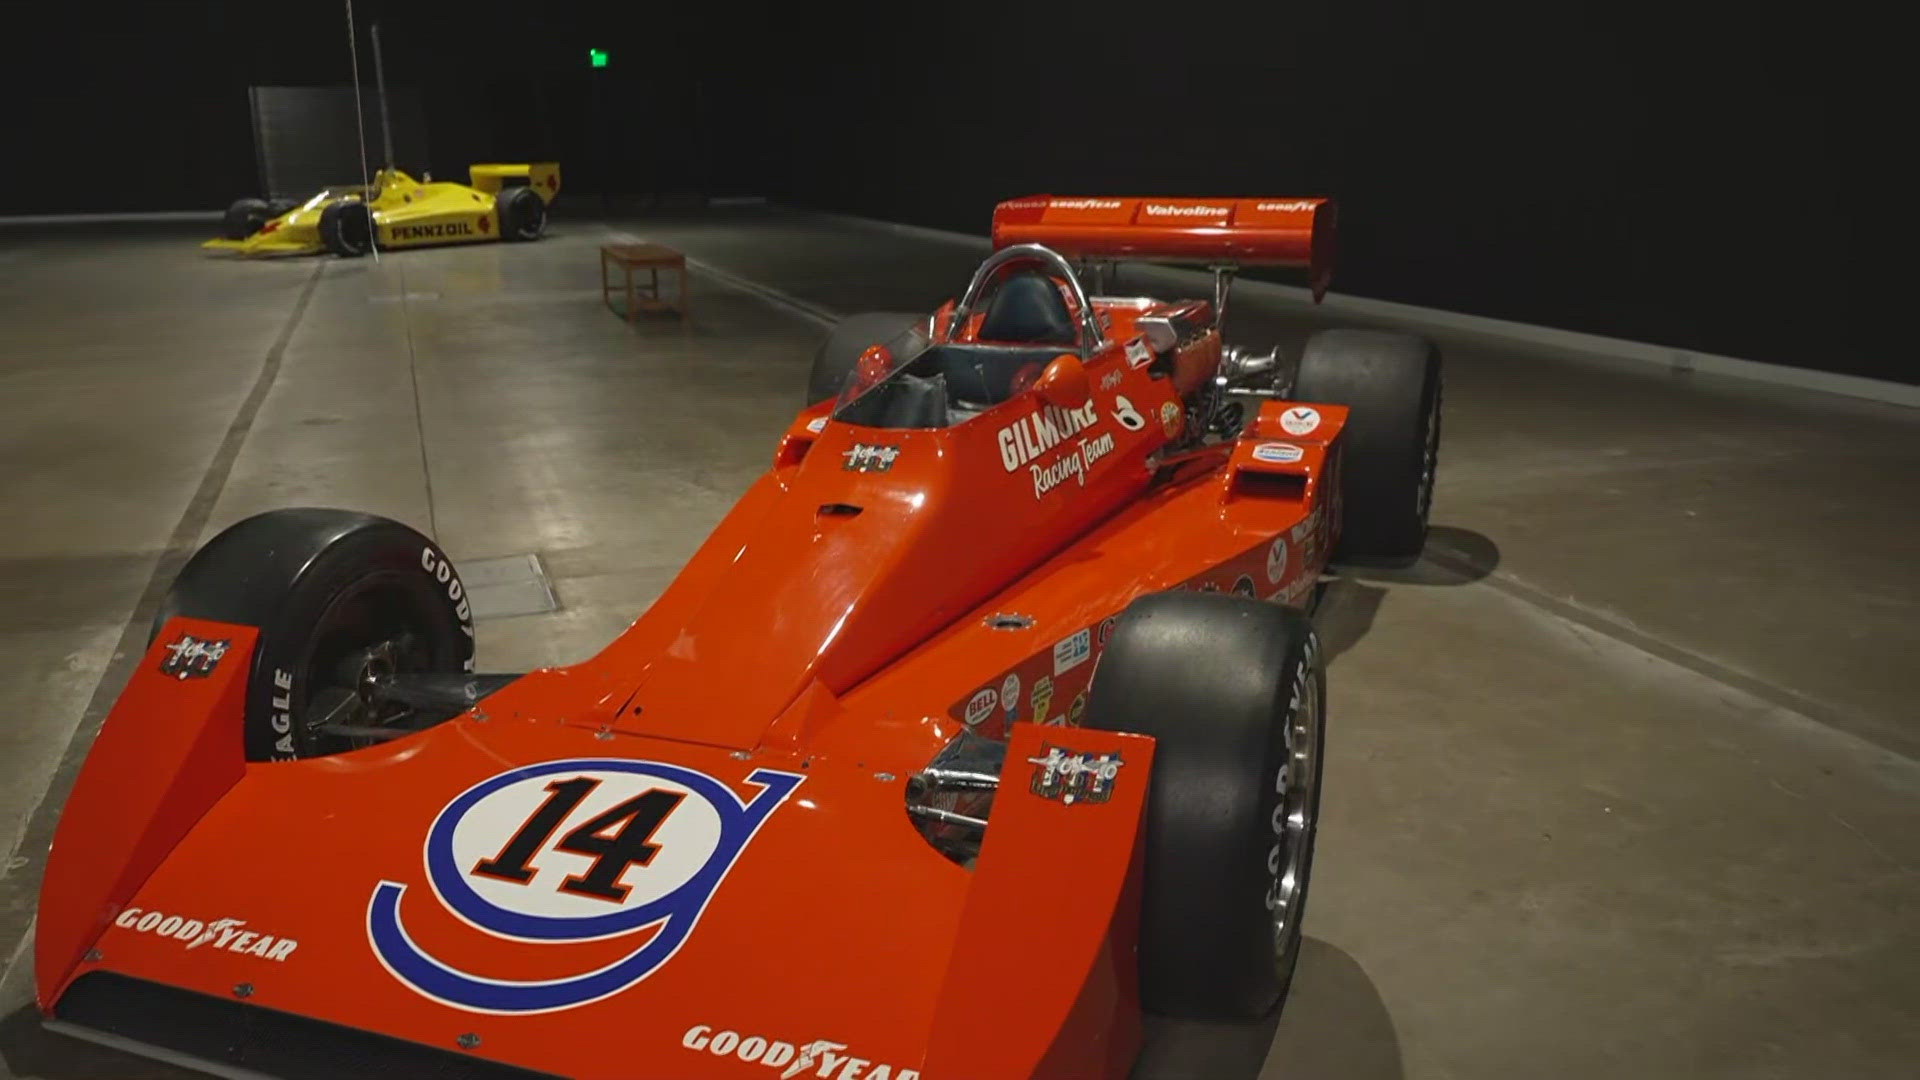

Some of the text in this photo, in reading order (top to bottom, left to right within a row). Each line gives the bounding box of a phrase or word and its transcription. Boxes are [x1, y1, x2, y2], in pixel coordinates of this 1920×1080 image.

[1145, 204, 1230, 218] Valvoline
[1028, 430, 1116, 501] Racing Team
[968, 691, 996, 716] BELL
[469, 774, 689, 906] 14
[114, 906, 299, 963] GOODYEAR
